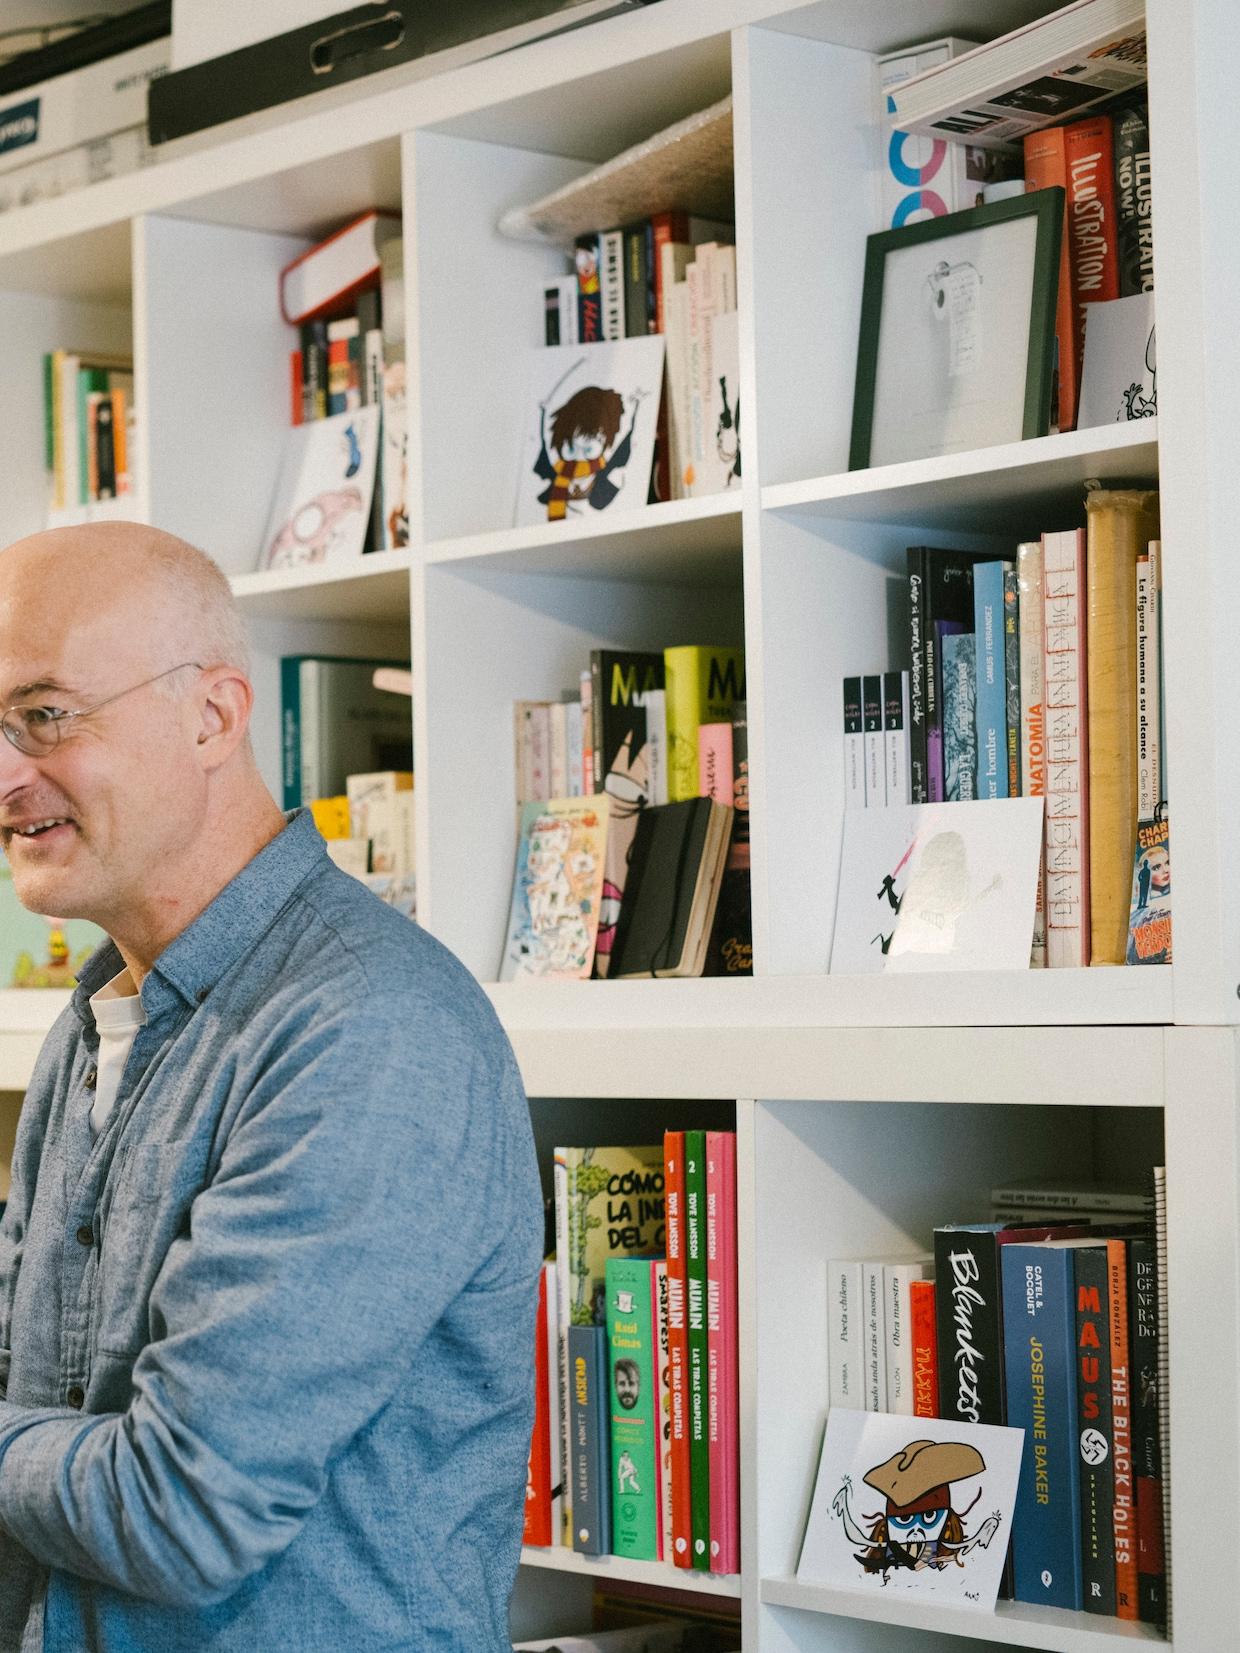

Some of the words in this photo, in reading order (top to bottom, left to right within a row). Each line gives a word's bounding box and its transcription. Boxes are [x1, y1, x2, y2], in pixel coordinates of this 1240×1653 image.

[1119, 155, 1135, 219] NOW!
[1070, 152, 1108, 291] ILLUSTRATION
[1139, 578, 1146, 592] La
[1138, 595, 1147, 631] figura
[985, 605, 993, 650] FERRANDEZ
[986, 656, 994, 684] CAMUS
[1031, 653, 1039, 665] EL
[1139, 636, 1147, 684] humana
[1031, 670, 1039, 695] PARA
[1140, 687, 1146, 695] a
[1140, 698, 1146, 712] su
[851, 721, 855, 730] 1
[870, 720, 876, 729] 2
[891, 718, 896, 728] 3
[1009, 728, 1017, 756] PLANETA
[1140, 715, 1149, 760] alcance
[960, 754, 971, 768] LA
[985, 728, 997, 776] hombre
[1141, 769, 1149, 790] Clem
[668, 1160, 675, 1173] 1
[688, 1161, 696, 1173] 2
[708, 1161, 715, 1173] 3
[607, 1201, 632, 1223] LA
[668, 1192, 678, 1215] TOVE
[688, 1192, 698, 1216] TOVE
[708, 1193, 716, 1216] TOVE
[608, 1226, 648, 1249] DEL
[669, 1217, 679, 1258] JANSSON
[689, 1217, 699, 1259] JANSSON
[708, 1217, 717, 1260] JANSSON
[839, 1274, 847, 1312] chileno
[869, 1275, 877, 1314] nosotros
[1025, 1265, 1035, 1316] BOCQUET
[1034, 1266, 1042, 1298] CATEL
[1111, 1266, 1119, 1295] BORJA
[668, 1278, 684, 1329] MUMIN
[688, 1278, 703, 1330] MUMIN
[708, 1279, 720, 1331] MUMIN
[1035, 1300, 1043, 1309] &
[614, 1320, 638, 1335] Raúl
[840, 1315, 848, 1343] Poeta
[870, 1316, 878, 1325] de
[1113, 1299, 1121, 1347] GONZÁLEZ
[611, 1335, 642, 1349] Cimas
[870, 1327, 879, 1358] atrás
[893, 1325, 901, 1347] Obra
[947, 1248, 986, 1424] Blankets
[671, 1347, 681, 1363] LAS
[691, 1348, 701, 1364] LAS
[709, 1349, 717, 1365] LAS
[1078, 1286, 1101, 1419] MAUS
[575, 1357, 588, 1406] ANSIEDAD
[673, 1365, 682, 1390] TIRAS
[692, 1366, 701, 1391] TIRAS
[710, 1367, 718, 1393] TIRAS
[871, 1361, 879, 1385] anda
[1111, 1366, 1127, 1406] THE
[1030, 1337, 1047, 1440] JOSEPHINE
[577, 1412, 587, 1446] MONTT
[674, 1392, 684, 1440] COMPLETAS
[693, 1392, 702, 1441] COMPLETAS
[710, 1395, 718, 1442] COMPLETAS
[1113, 1416, 1130, 1486] BLACK
[578, 1454, 588, 1502] ALBERTO
[1034, 1445, 1049, 1505] BAKER
[1090, 1474, 1098, 1559] SPIEGELMAN
[1113, 1494, 1130, 1564] HOLES
[1090, 1582, 1101, 1597] R
